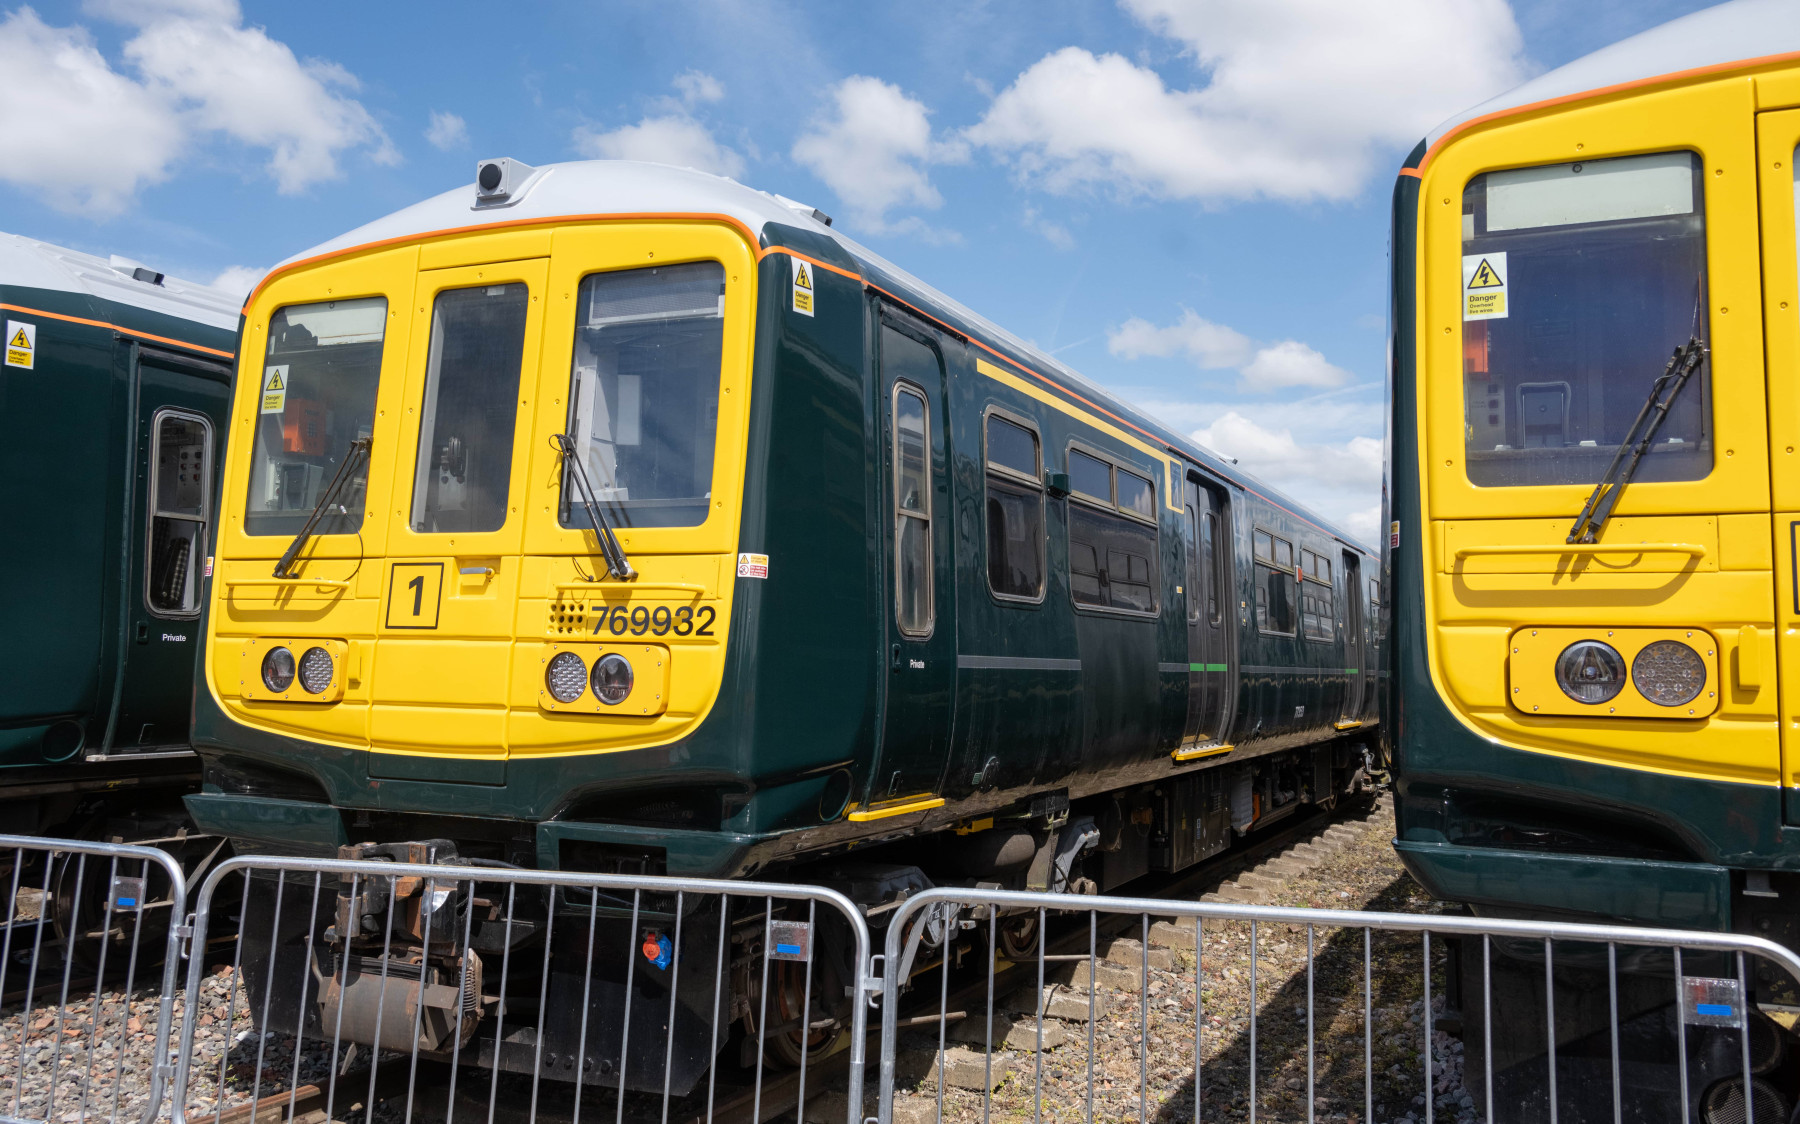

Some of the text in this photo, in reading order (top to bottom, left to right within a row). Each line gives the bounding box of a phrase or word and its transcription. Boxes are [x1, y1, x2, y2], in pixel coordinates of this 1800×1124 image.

[1469, 295, 1497, 303] Danger
[8, 349, 28, 357] Danger
[408, 575, 425, 617] 1
[591, 605, 717, 637] 769932
[162, 633, 187, 642] Private
[909, 658, 925, 669] Private
